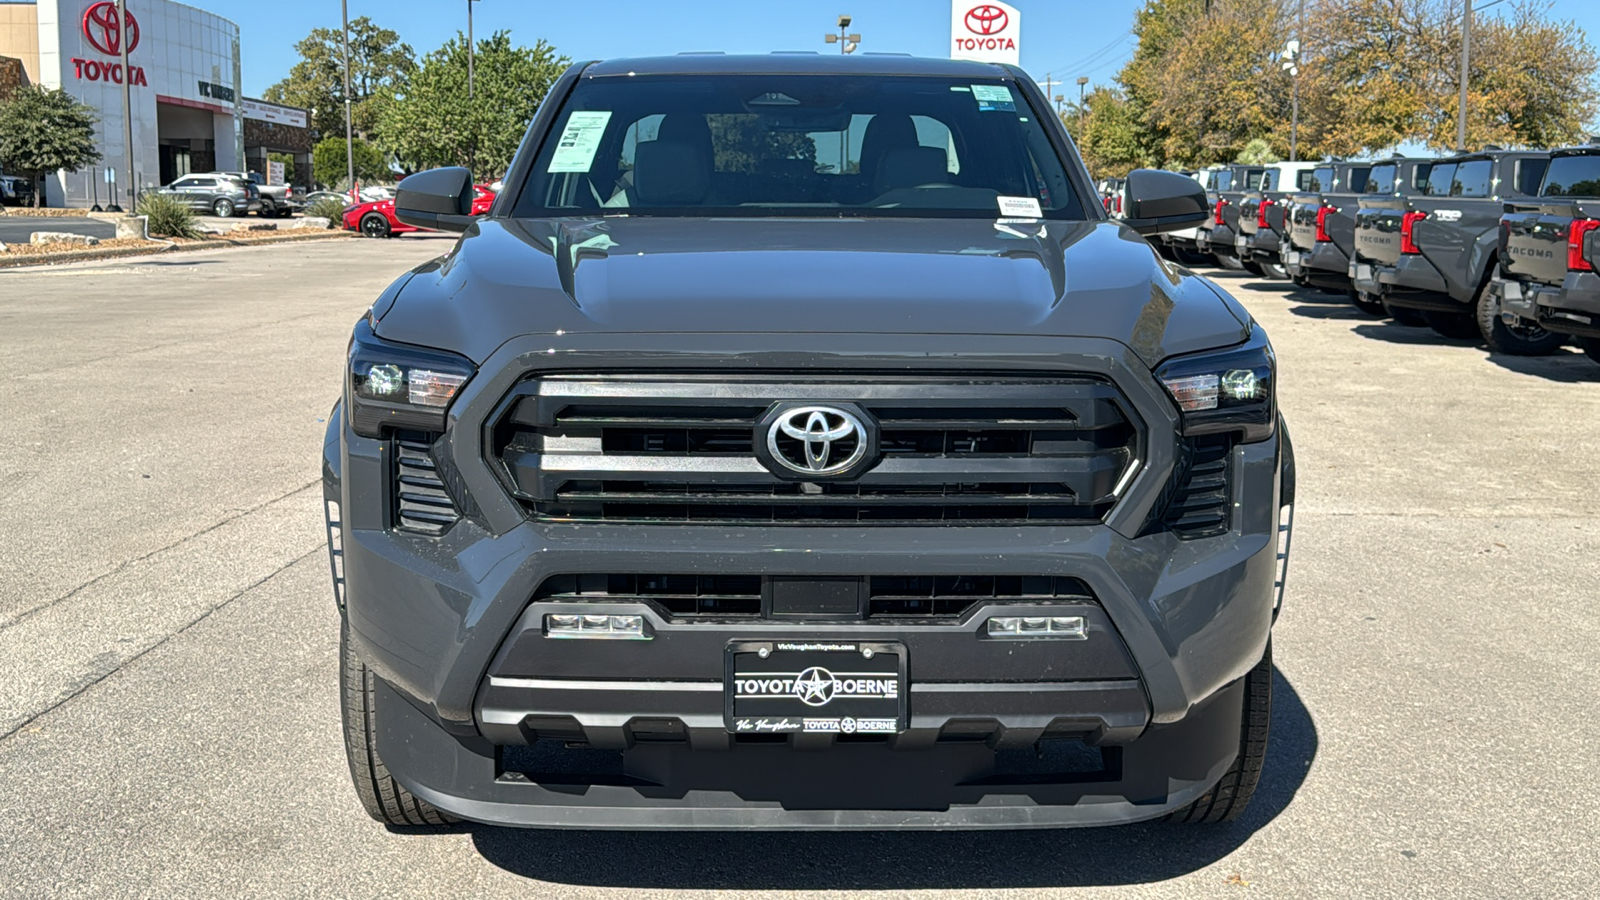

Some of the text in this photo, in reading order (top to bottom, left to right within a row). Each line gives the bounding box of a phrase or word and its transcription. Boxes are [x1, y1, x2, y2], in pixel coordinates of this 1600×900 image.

[955, 38, 1016, 51] TOYOTA
[70, 57, 148, 87] TOYOTA
[1434, 209, 1462, 219] TRD
[1360, 235, 1391, 244] TACOMA
[1507, 245, 1553, 259] TACOMA
[777, 643, 856, 651] VicVaughanToyota.com
[735, 680, 805, 693] TOYOTA
[833, 680, 898, 694] BOERNE
[755, 718, 801, 732] Vaughan
[803, 721, 897, 730] TOYOTA BOERNE
